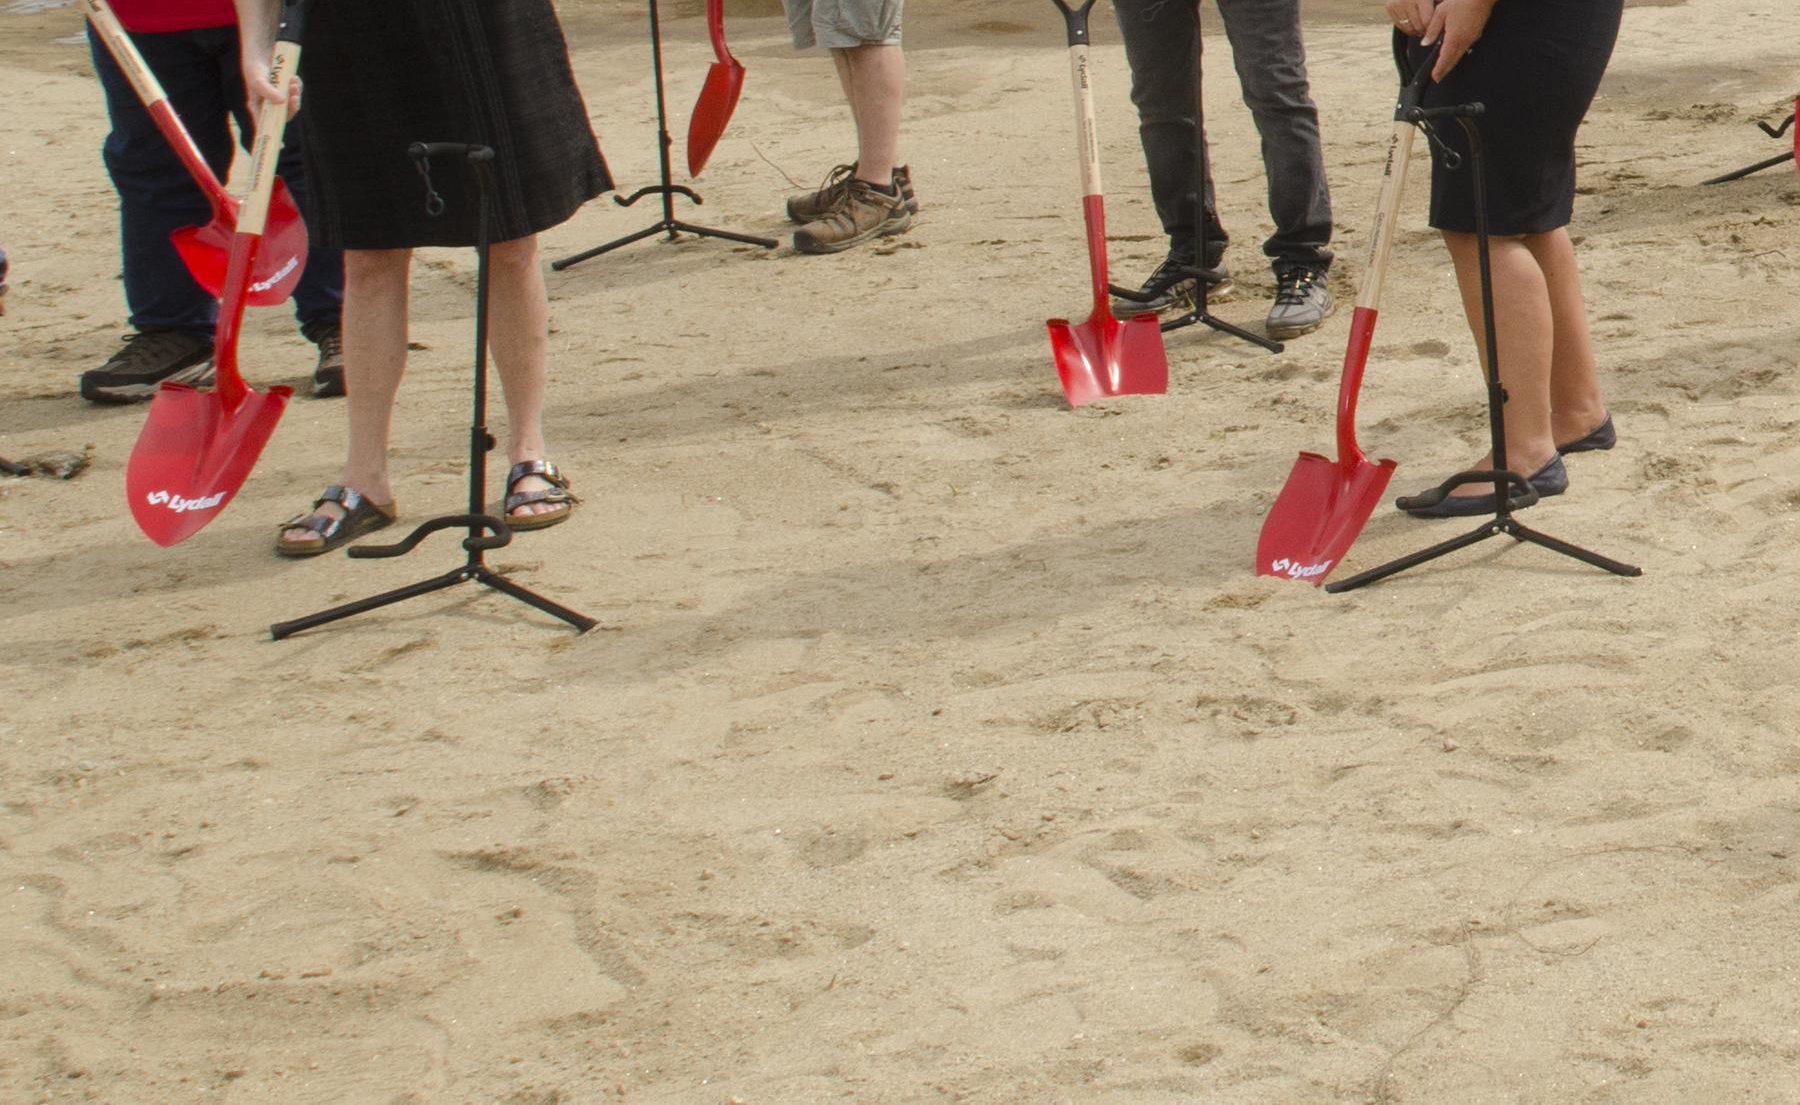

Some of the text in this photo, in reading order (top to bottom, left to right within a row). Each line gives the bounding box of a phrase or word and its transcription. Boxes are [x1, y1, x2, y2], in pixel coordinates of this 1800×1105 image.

[253, 255, 298, 292] Lydall
[168, 492, 225, 513] Lydall
[1288, 560, 1330, 579] Lydall
